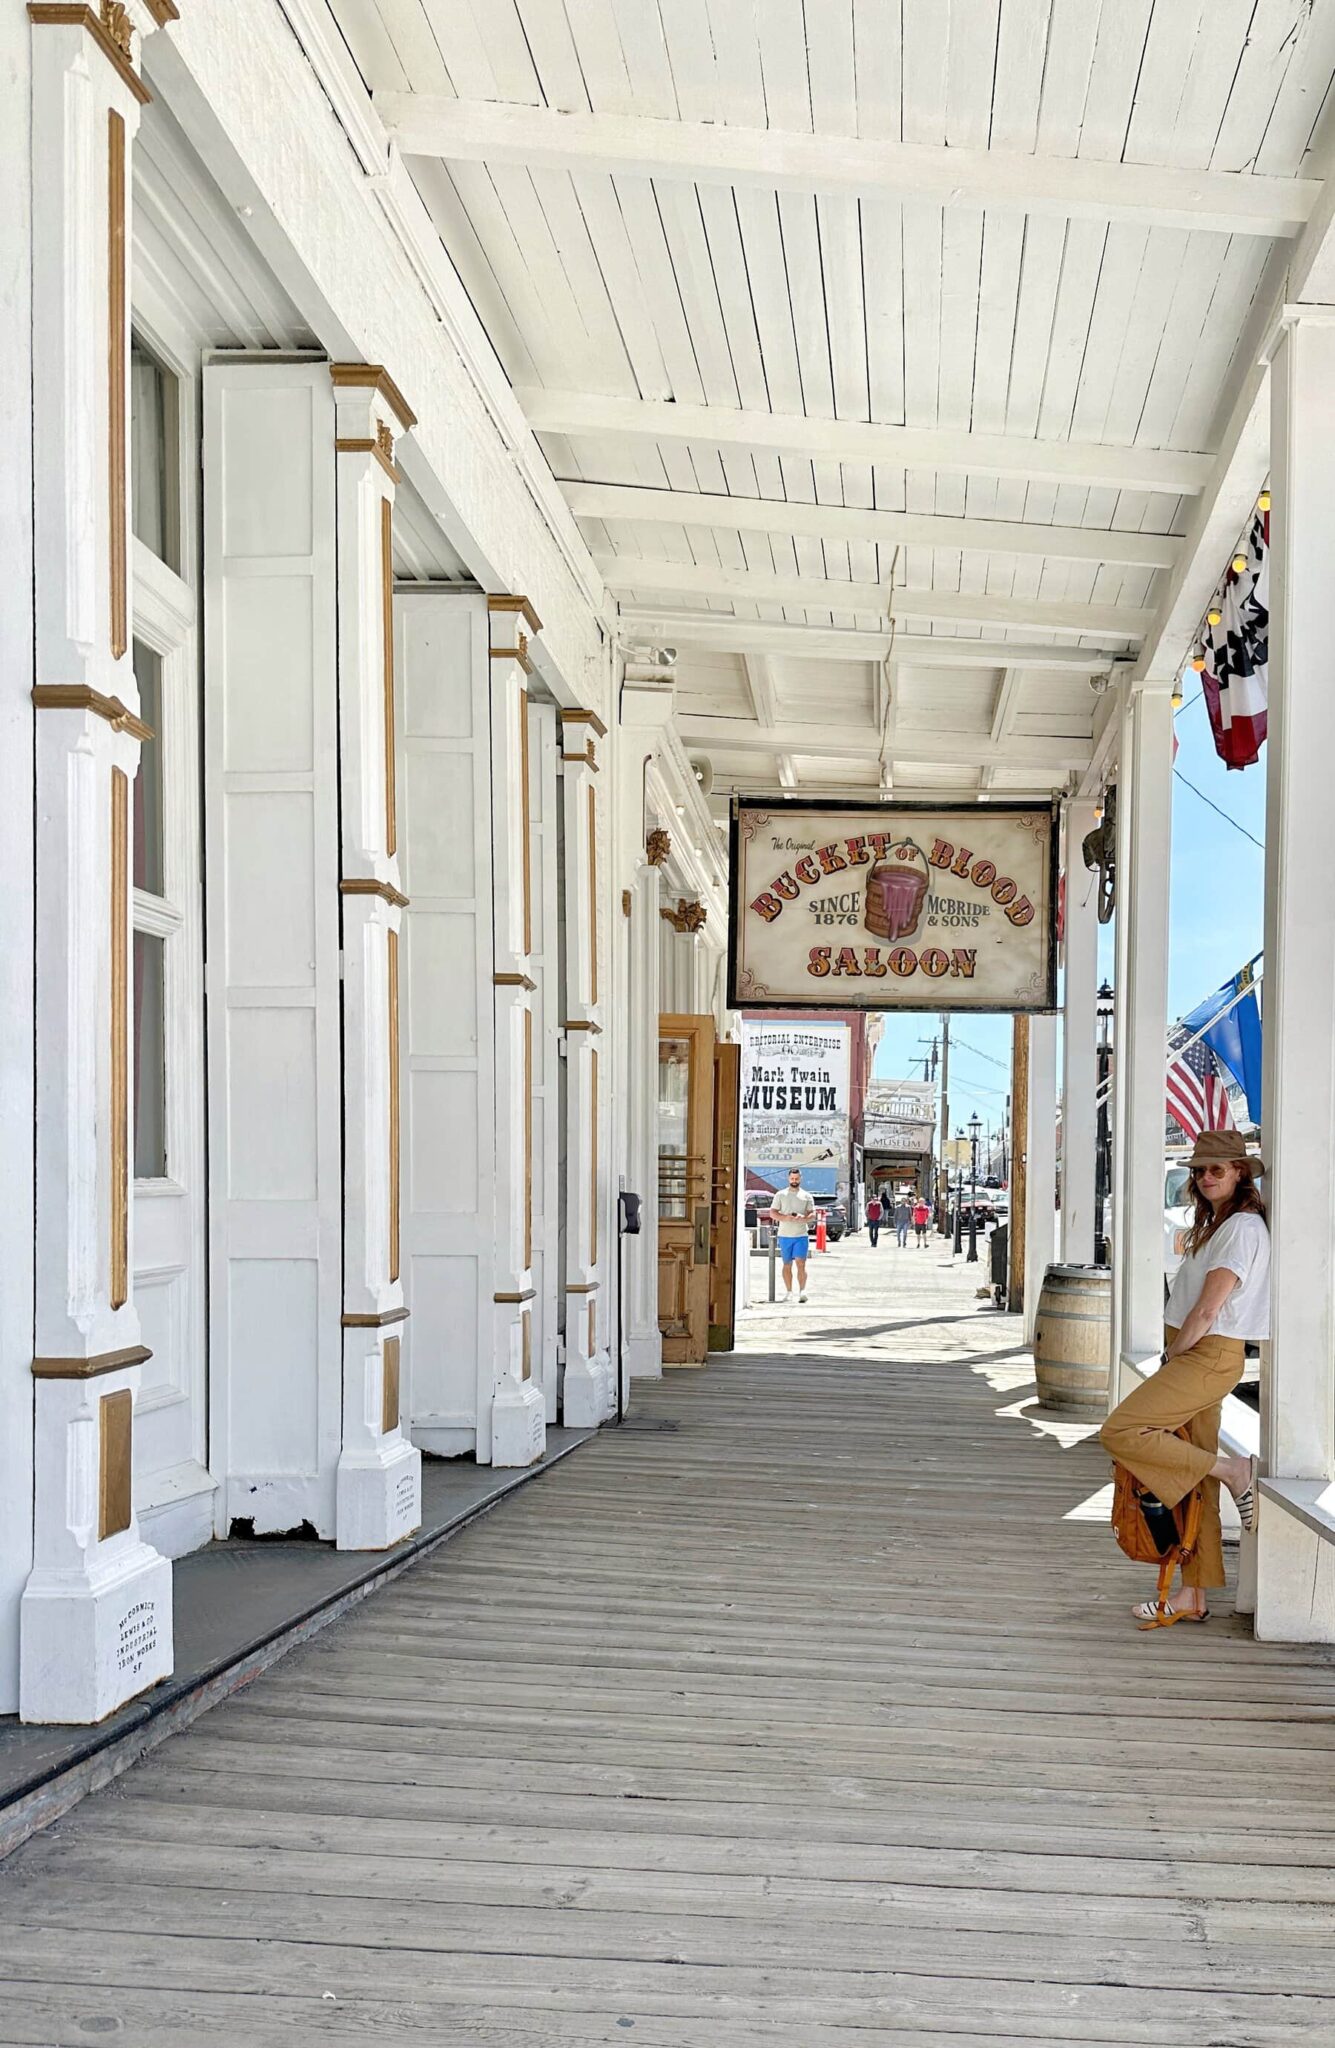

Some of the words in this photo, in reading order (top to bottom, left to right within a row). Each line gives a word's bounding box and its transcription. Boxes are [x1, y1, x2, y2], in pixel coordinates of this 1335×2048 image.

[771, 837, 786, 851] The
[786, 838, 815, 854] Original
[750, 832, 891, 922] BUCKET
[895, 848, 919, 861] OF
[927, 838, 1037, 927] BLOOD
[808, 891, 861, 913] SINCE
[813, 914, 858, 926] 1876
[927, 915, 939, 927] &
[941, 915, 979, 927] SONS
[806, 946, 978, 978] SALOON
[793, 1033, 841, 1049] ENTERPRISE
[751, 1066, 785, 1083] Mark
[791, 1067, 831, 1084] Twain
[742, 1086, 836, 1110] MUSEUM
[820, 1125, 834, 1137] City
[873, 1138, 921, 1148] MUSEUM
[120, 1624, 140, 1641] LEWIS
[116, 1626, 157, 1657] INDUSTRIAL
[118, 1653, 134, 1670] IRON
[137, 1640, 156, 1656] WORKS
[133, 1662, 142, 1674] SF
